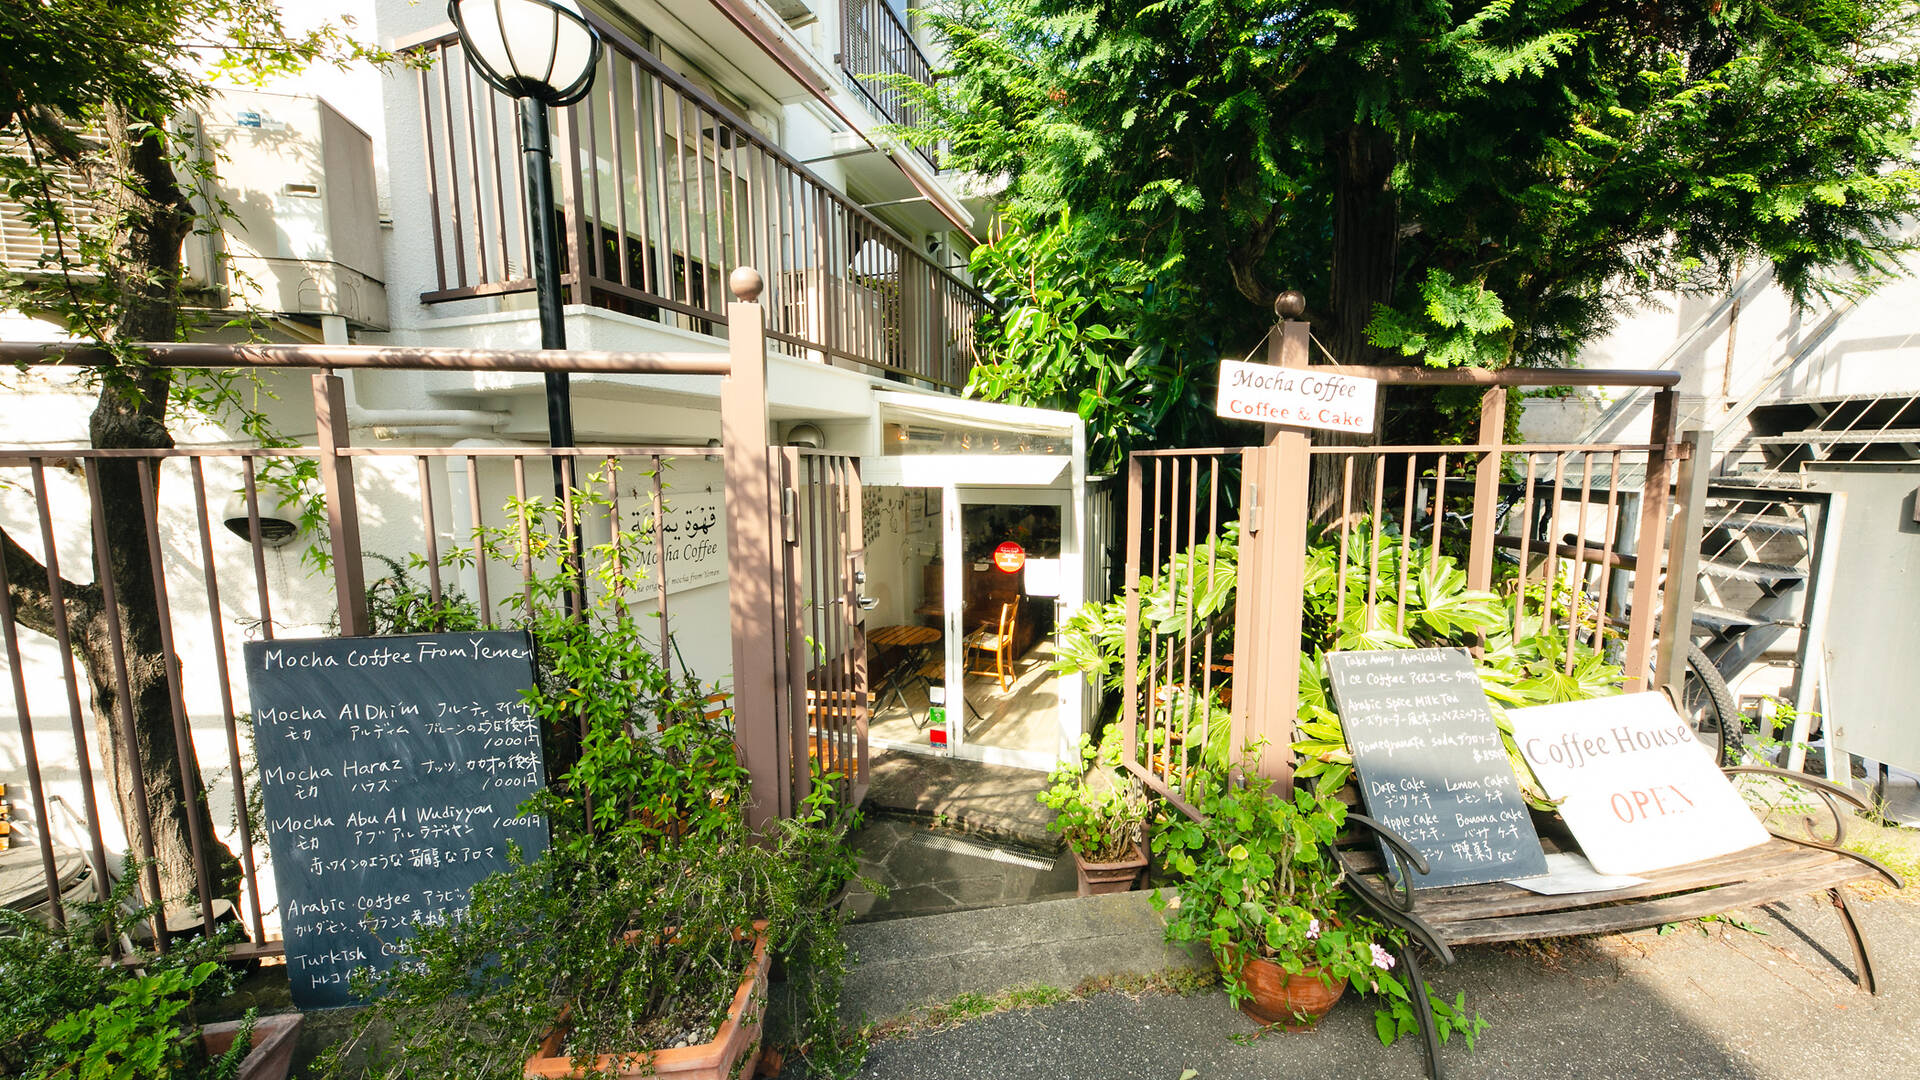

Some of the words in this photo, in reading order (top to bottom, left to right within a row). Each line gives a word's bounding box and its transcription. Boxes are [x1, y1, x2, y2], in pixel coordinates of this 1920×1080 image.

[1232, 369, 1294, 392] Mocha
[1300, 376, 1356, 402] Coffee
[1230, 399, 1290, 419] Coffee
[1298, 407, 1311, 421] &
[1318, 409, 1364, 427] Cake
[636, 545, 680, 568] Moha
[683, 540, 718, 563] Coffee
[265, 649, 339, 670] Mocha
[347, 647, 413, 668] Coffee
[416, 642, 466, 663] From
[469, 637, 533, 661] Yemen
[1344, 656, 1367, 668] Take
[1400, 652, 1448, 665] Available
[1367, 672, 1406, 687] Coffee
[258, 705, 327, 726] Mocha
[1348, 698, 1381, 713] Arabic
[1386, 697, 1413, 712] Spice
[285, 726, 311, 741] モカ
[350, 722, 410, 741] アルディム
[484, 734, 540, 749] 1000円
[1525, 731, 1610, 769] Coffee
[1610, 724, 1692, 753] House
[265, 765, 334, 785] Mocha
[343, 759, 403, 778] Haraz
[482, 771, 538, 791] 1000円
[294, 784, 318, 800] モカ
[351, 780, 398, 793] ハラズ
[1371, 780, 1397, 797] Date
[1400, 776, 1427, 791] Cake
[1444, 778, 1481, 792] Lemon
[1484, 774, 1510, 788] Cake
[271, 814, 335, 834] Mocha
[346, 810, 379, 828] Abu
[384, 807, 406, 824] Al
[416, 804, 493, 823] Wudiyyan
[493, 814, 540, 829] 1000円
[1383, 814, 1411, 831] Apple
[1413, 812, 1439, 826] Cake
[1455, 812, 1498, 828] Banana
[1500, 809, 1524, 823] Cake
[296, 835, 319, 851] モカ
[354, 830, 385, 845] アブ
[392, 827, 415, 842] アル
[1397, 827, 1439, 842] んごケーキ
[287, 898, 346, 921] Arabic
[357, 892, 411, 911] Coffee
[294, 946, 367, 970] Turkish
